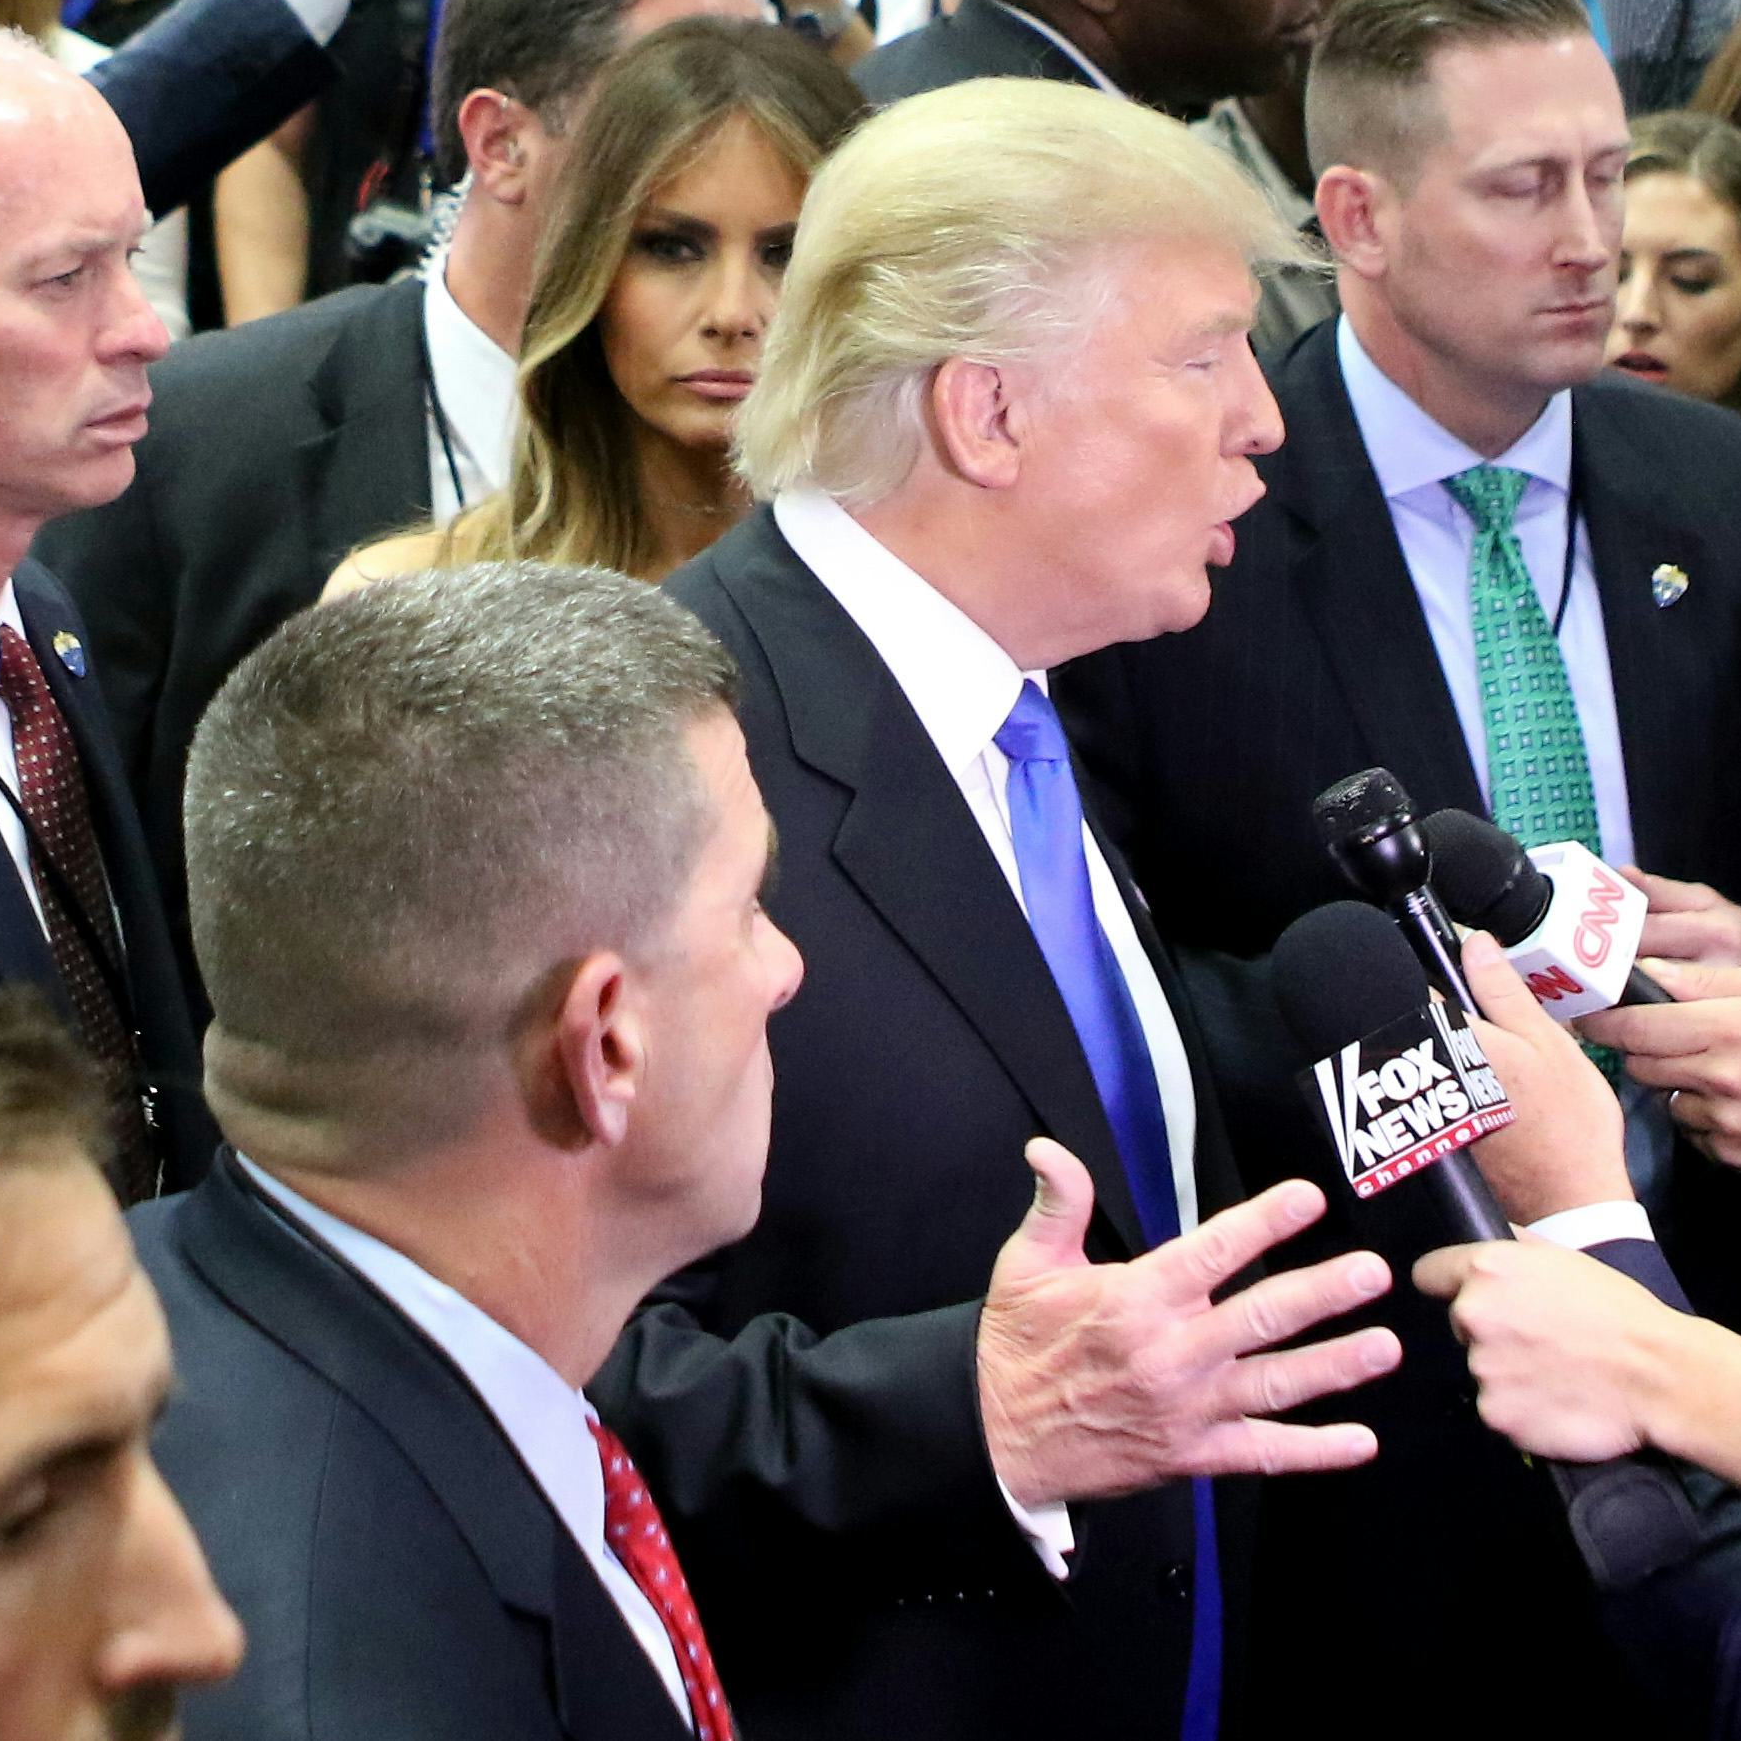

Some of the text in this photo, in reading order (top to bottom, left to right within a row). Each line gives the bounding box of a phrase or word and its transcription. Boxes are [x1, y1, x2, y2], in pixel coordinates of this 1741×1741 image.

[1573, 866, 1625, 969] CNN
[1353, 1037, 1452, 1119] FOX
[1351, 1079, 1471, 1169] NEWS
[1357, 1116, 1484, 1198] channel
